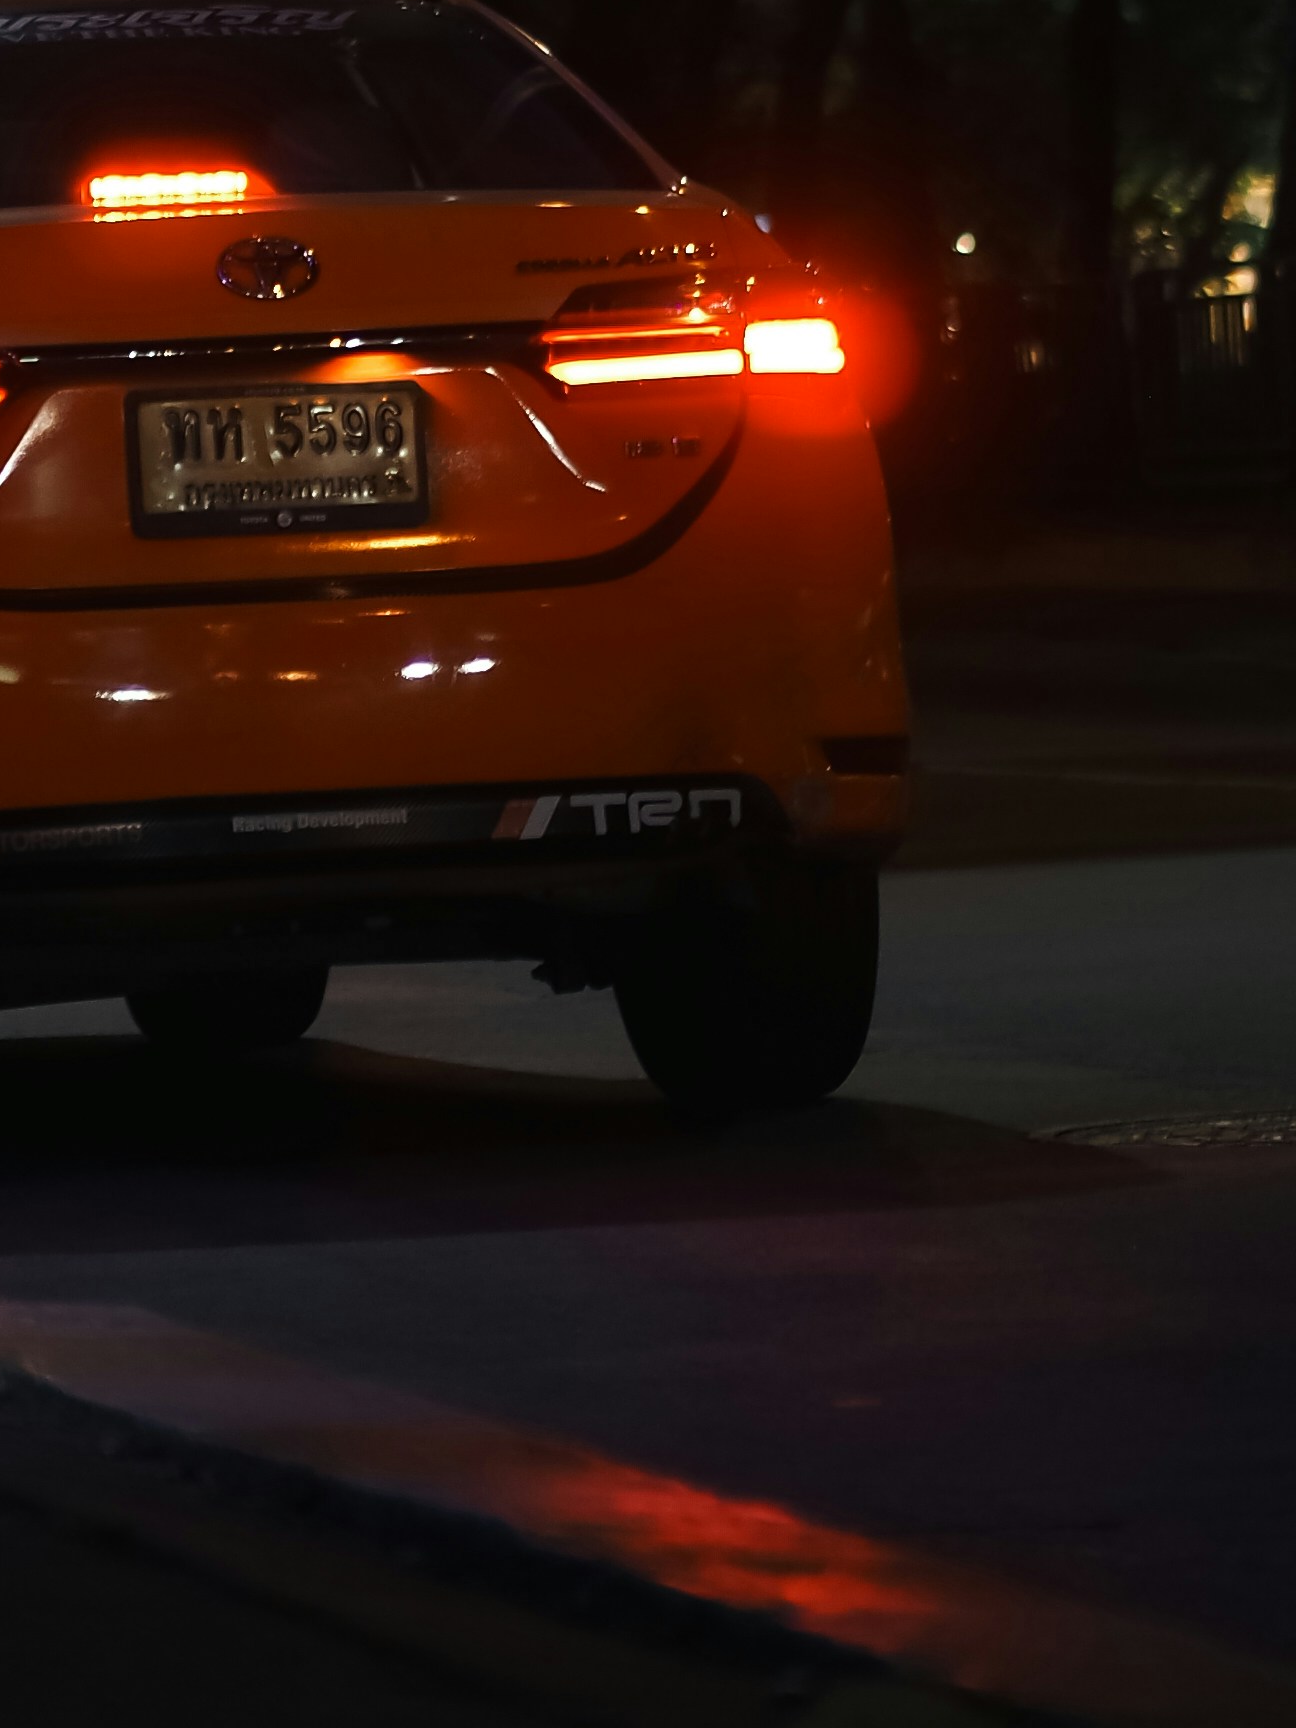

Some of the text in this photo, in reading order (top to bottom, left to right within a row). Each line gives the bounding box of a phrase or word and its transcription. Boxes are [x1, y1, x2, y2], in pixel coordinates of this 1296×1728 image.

[274, 401, 403, 458] 5596
[232, 814, 292, 834] Racing
[297, 807, 408, 829] Development
